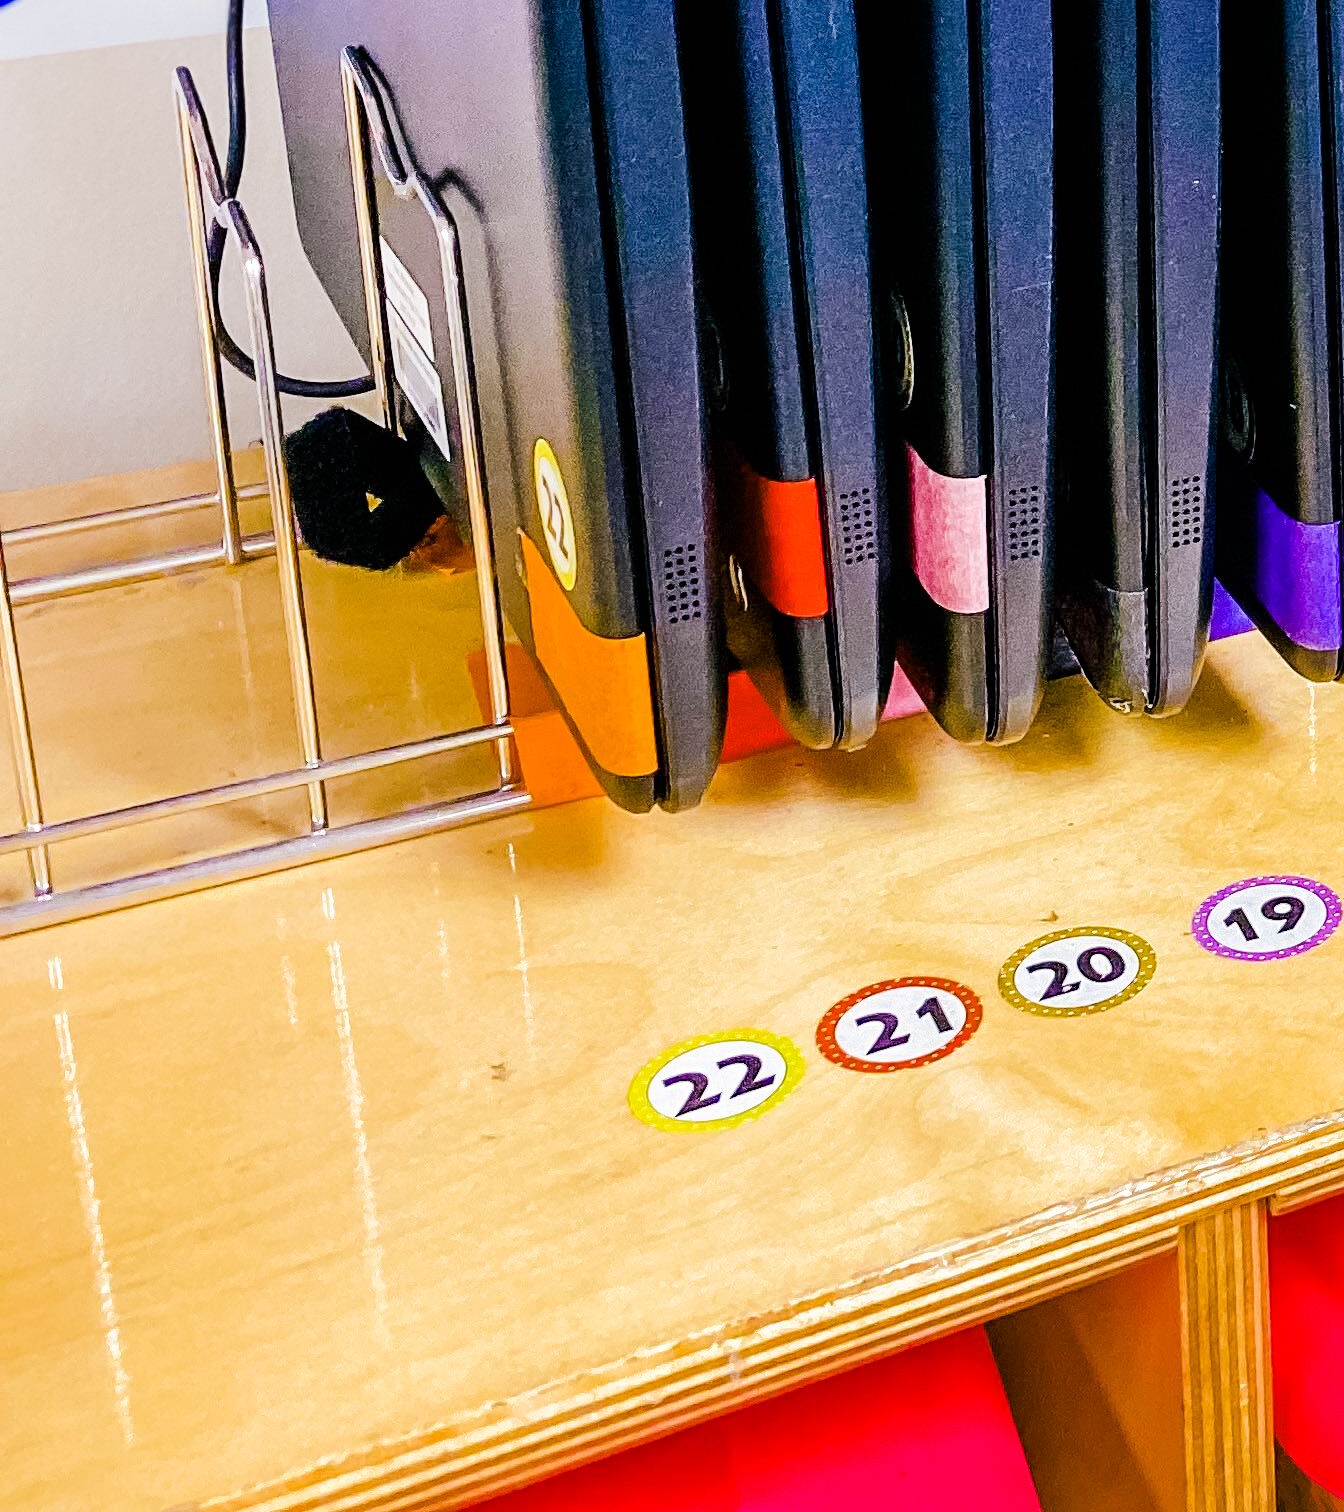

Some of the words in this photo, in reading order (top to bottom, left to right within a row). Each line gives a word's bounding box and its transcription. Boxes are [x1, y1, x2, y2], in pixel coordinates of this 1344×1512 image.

[1223, 896, 1305, 942] 19
[1026, 946, 1126, 1002] 20
[856, 996, 956, 1056] 21
[662, 1054, 776, 1117] 22
